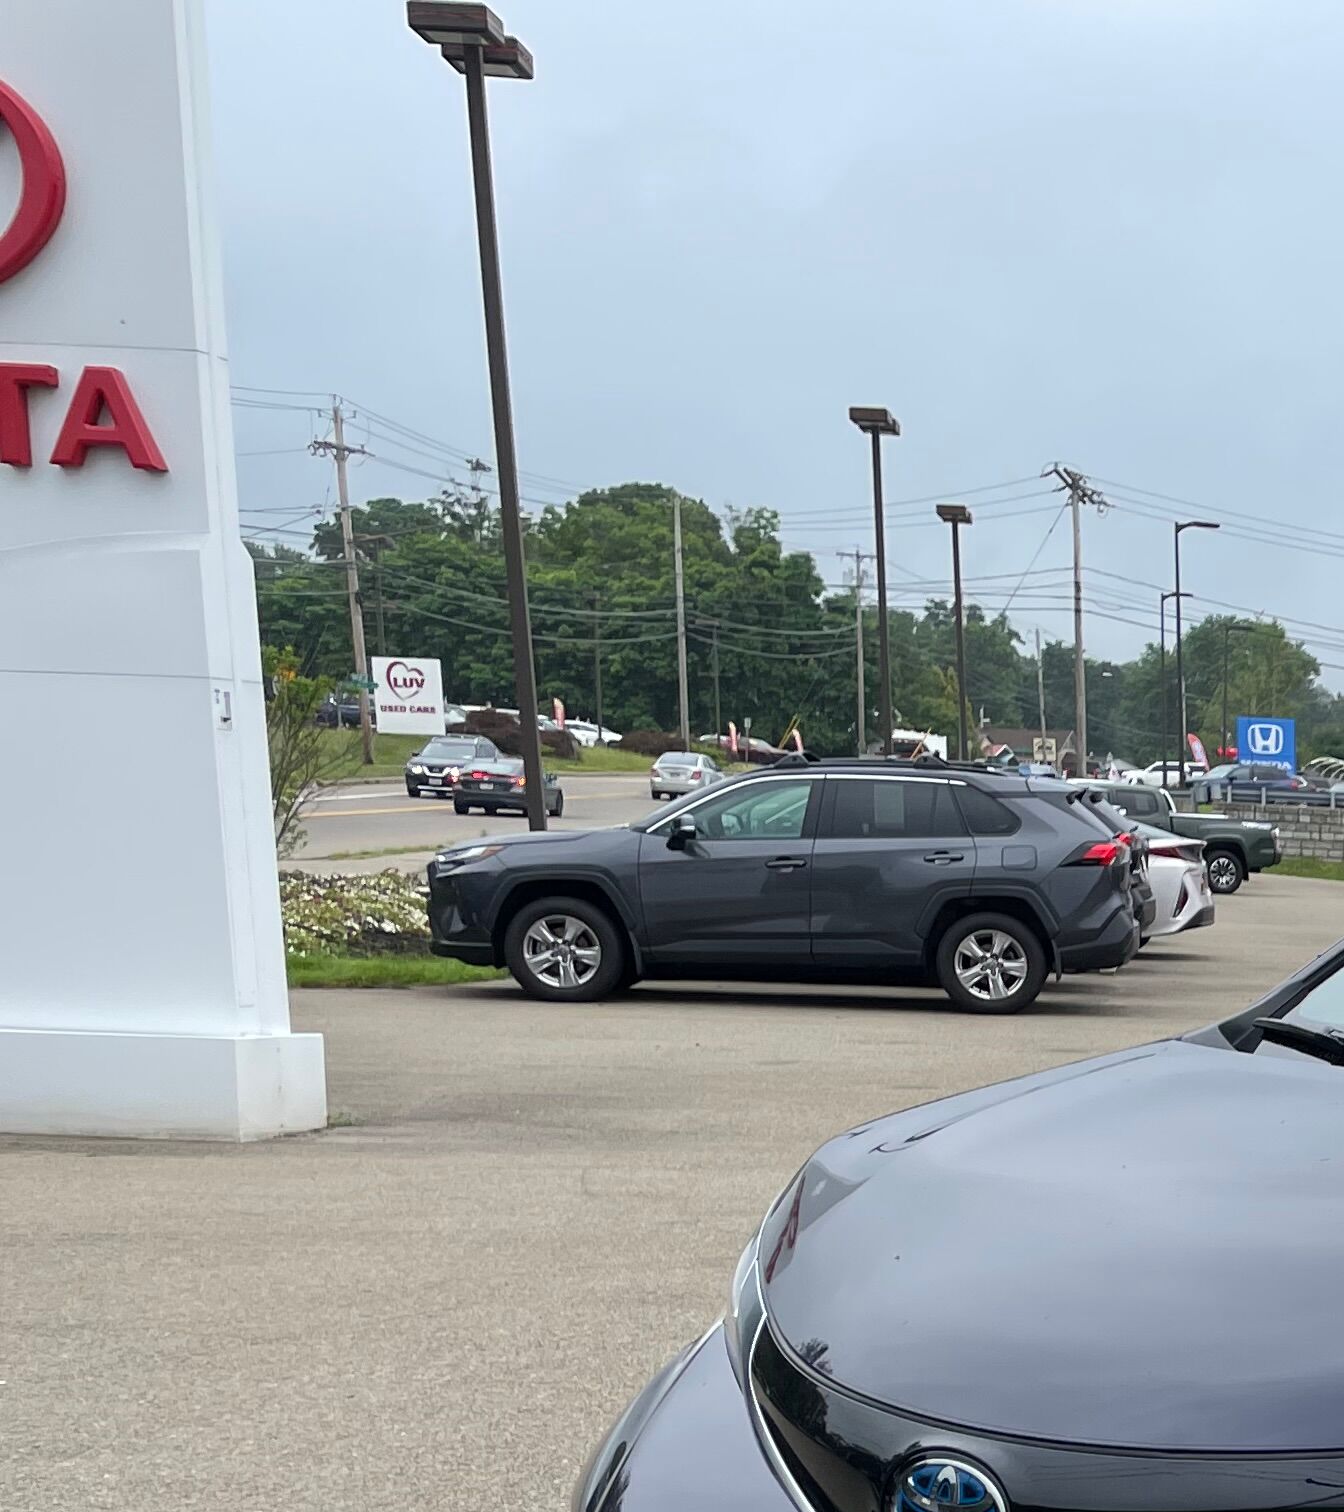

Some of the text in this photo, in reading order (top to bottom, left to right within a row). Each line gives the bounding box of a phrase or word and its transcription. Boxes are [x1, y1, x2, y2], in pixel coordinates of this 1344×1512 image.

[393, 677, 425, 688] LUV
[380, 705, 436, 714] USED CARS
